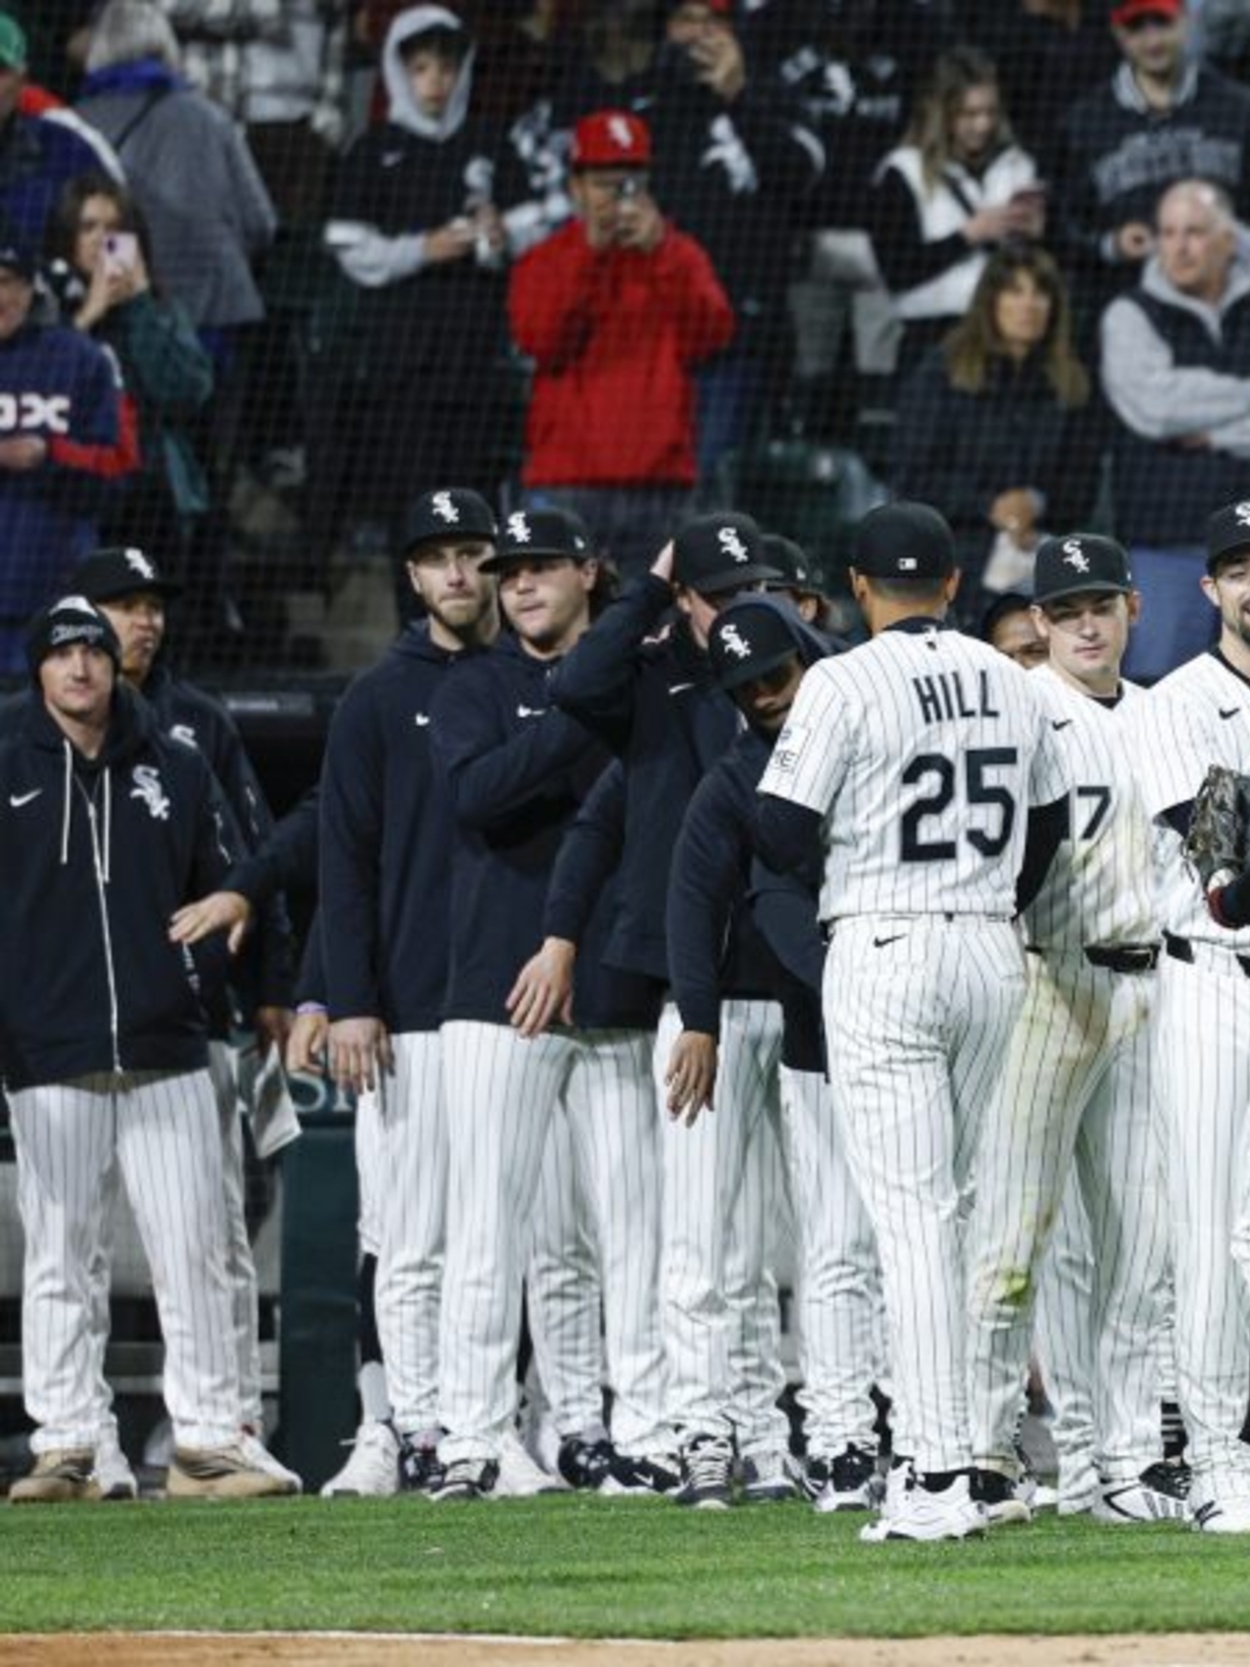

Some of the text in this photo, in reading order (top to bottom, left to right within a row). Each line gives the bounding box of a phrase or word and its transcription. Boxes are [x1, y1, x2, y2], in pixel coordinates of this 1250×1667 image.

[913, 669, 999, 724] HILL
[902, 747, 1018, 862] 25
[1062, 786, 1112, 842] 7
